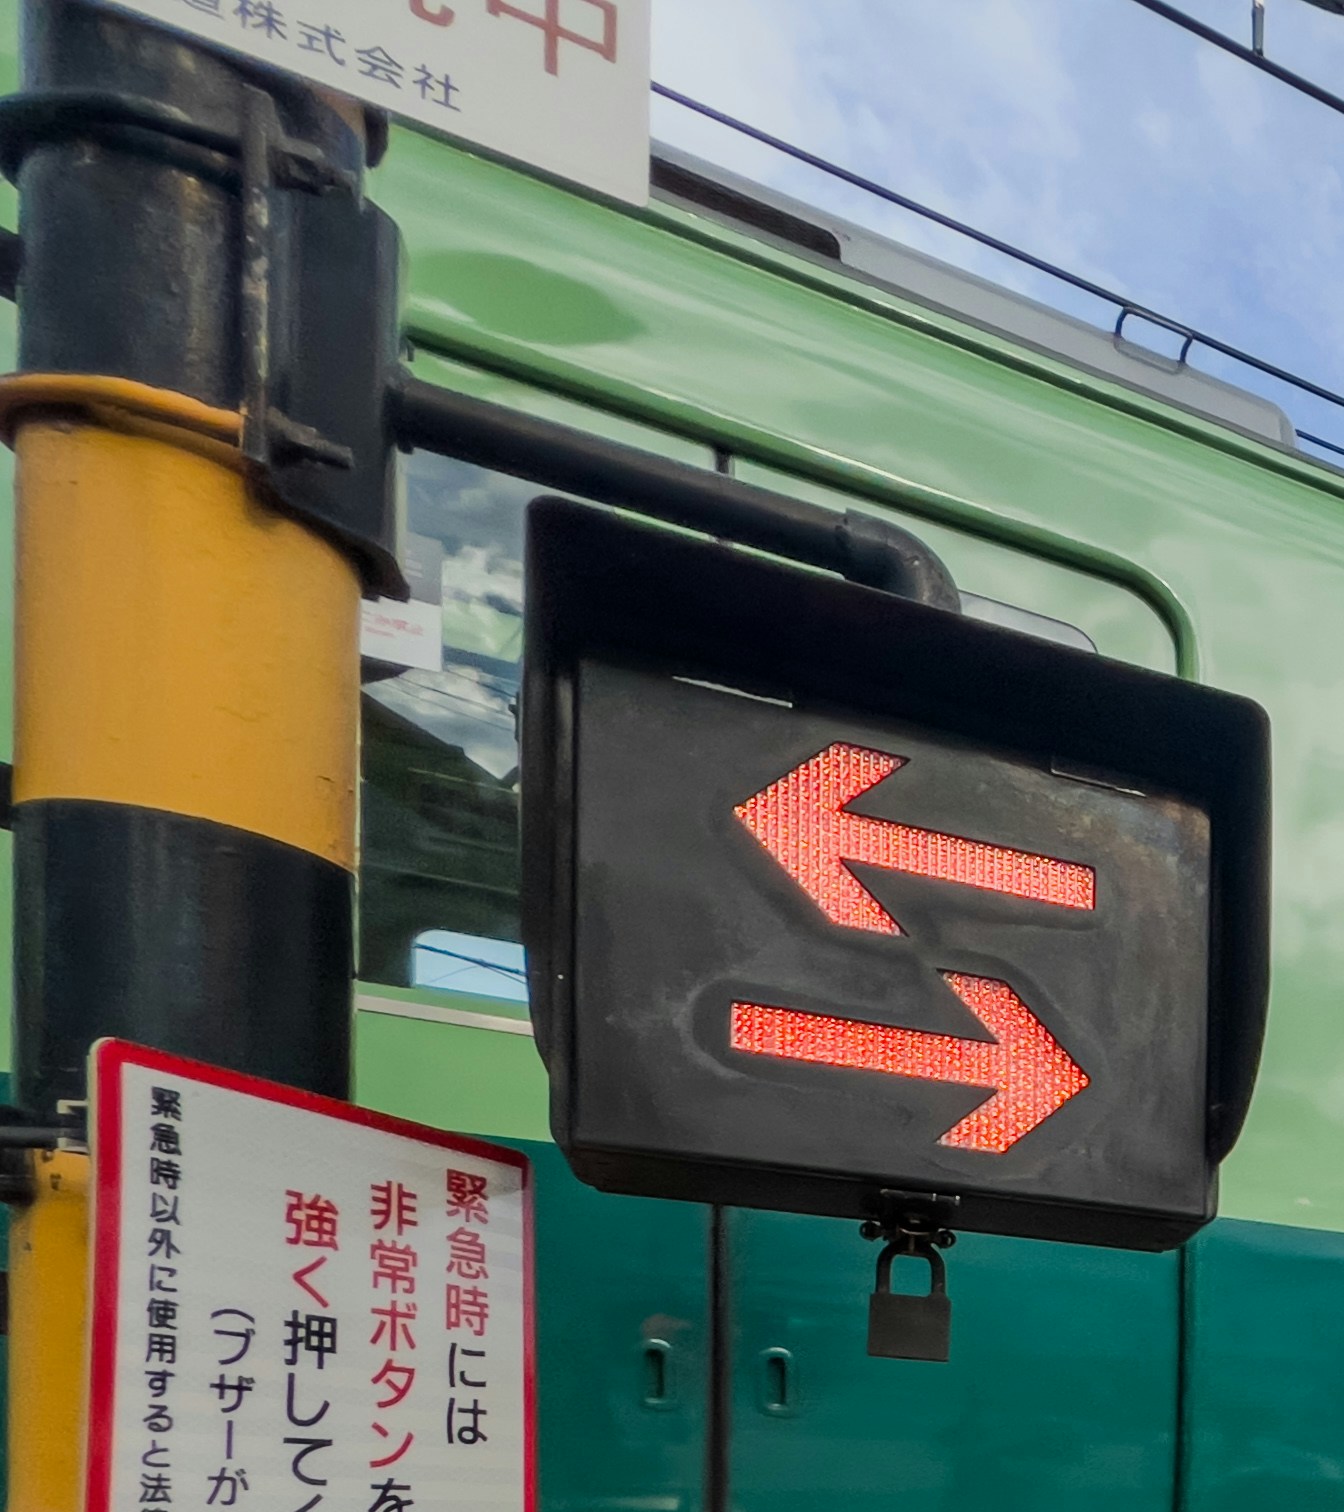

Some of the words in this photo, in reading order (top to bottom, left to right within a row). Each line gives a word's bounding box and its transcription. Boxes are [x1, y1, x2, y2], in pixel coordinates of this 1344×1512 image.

[446, 1168, 490, 1446] 緊急時には
